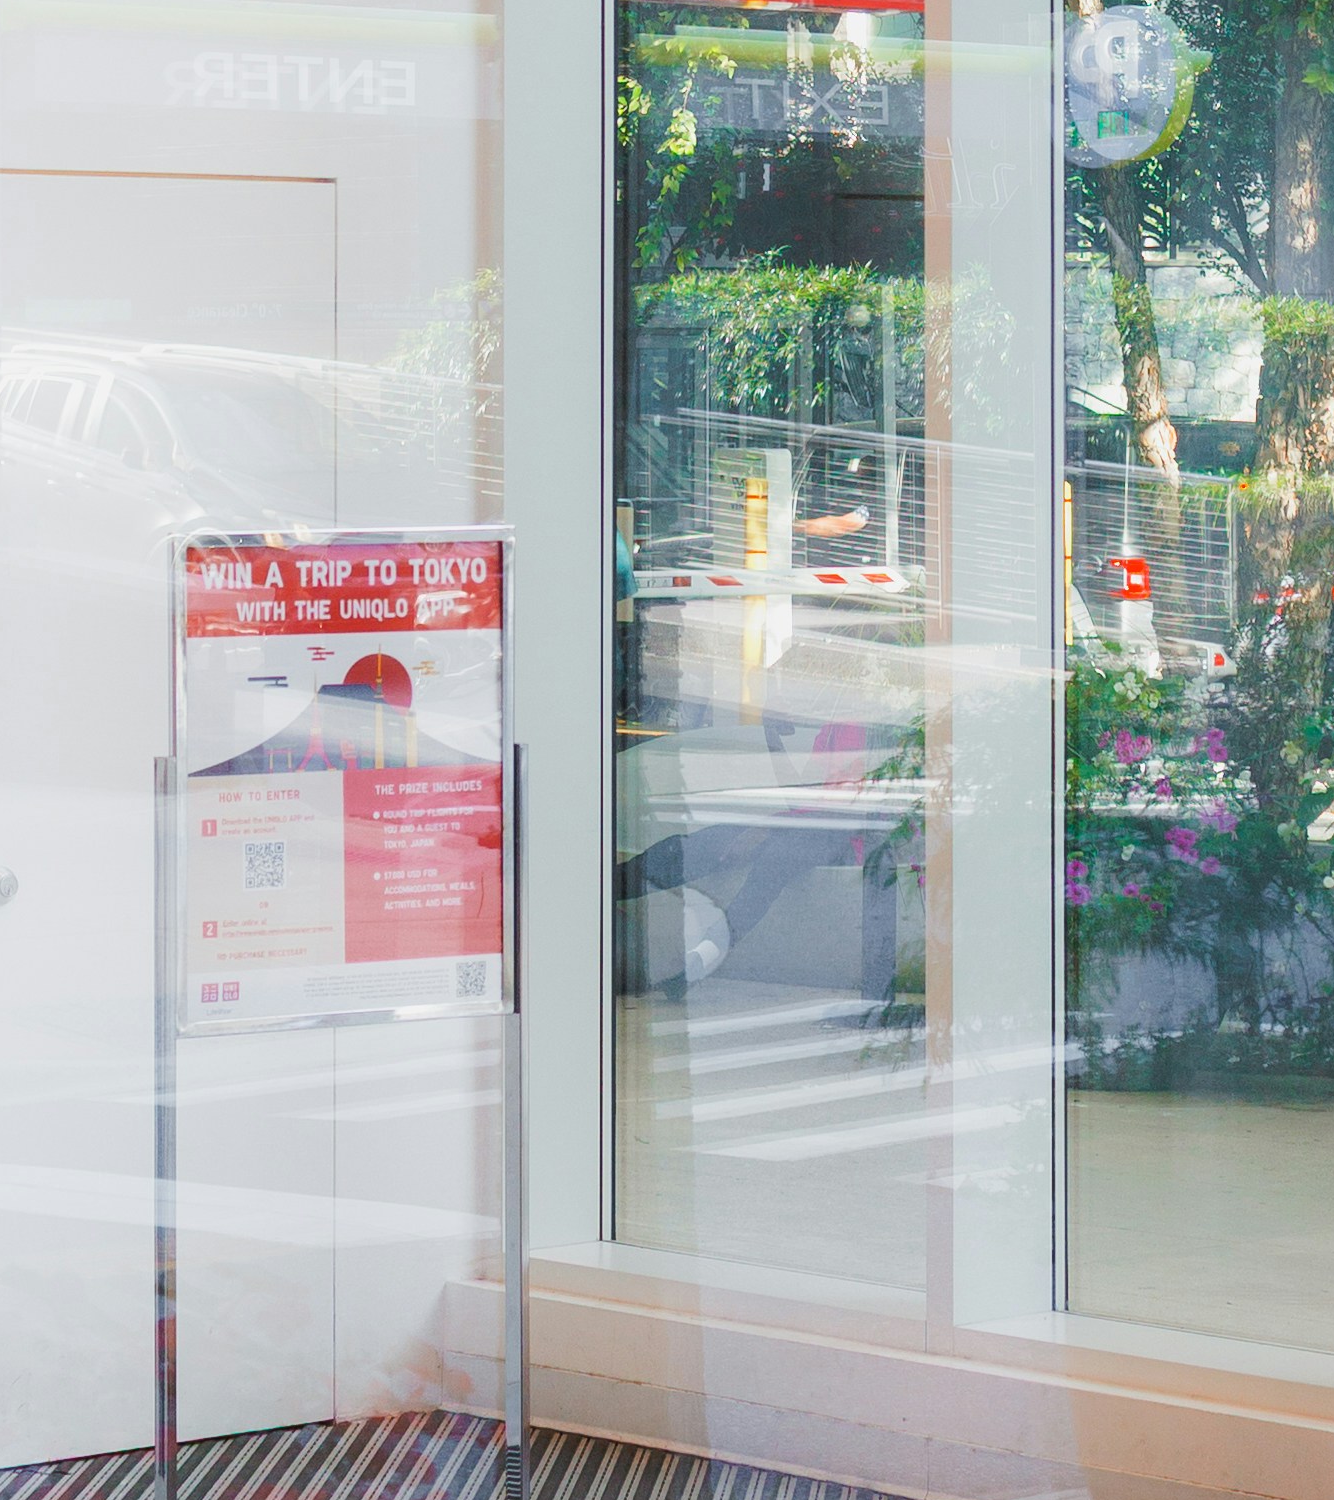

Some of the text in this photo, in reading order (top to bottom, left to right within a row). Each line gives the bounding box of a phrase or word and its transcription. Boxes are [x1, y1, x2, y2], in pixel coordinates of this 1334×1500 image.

[201, 557, 488, 590] WIN A TRIP TO TOKYO
[236, 598, 456, 622] WITH THE UNIQLO APP
[218, 789, 301, 803] HOW TO ENTER
[375, 780, 483, 795] THE PRIZE INCLUDES
